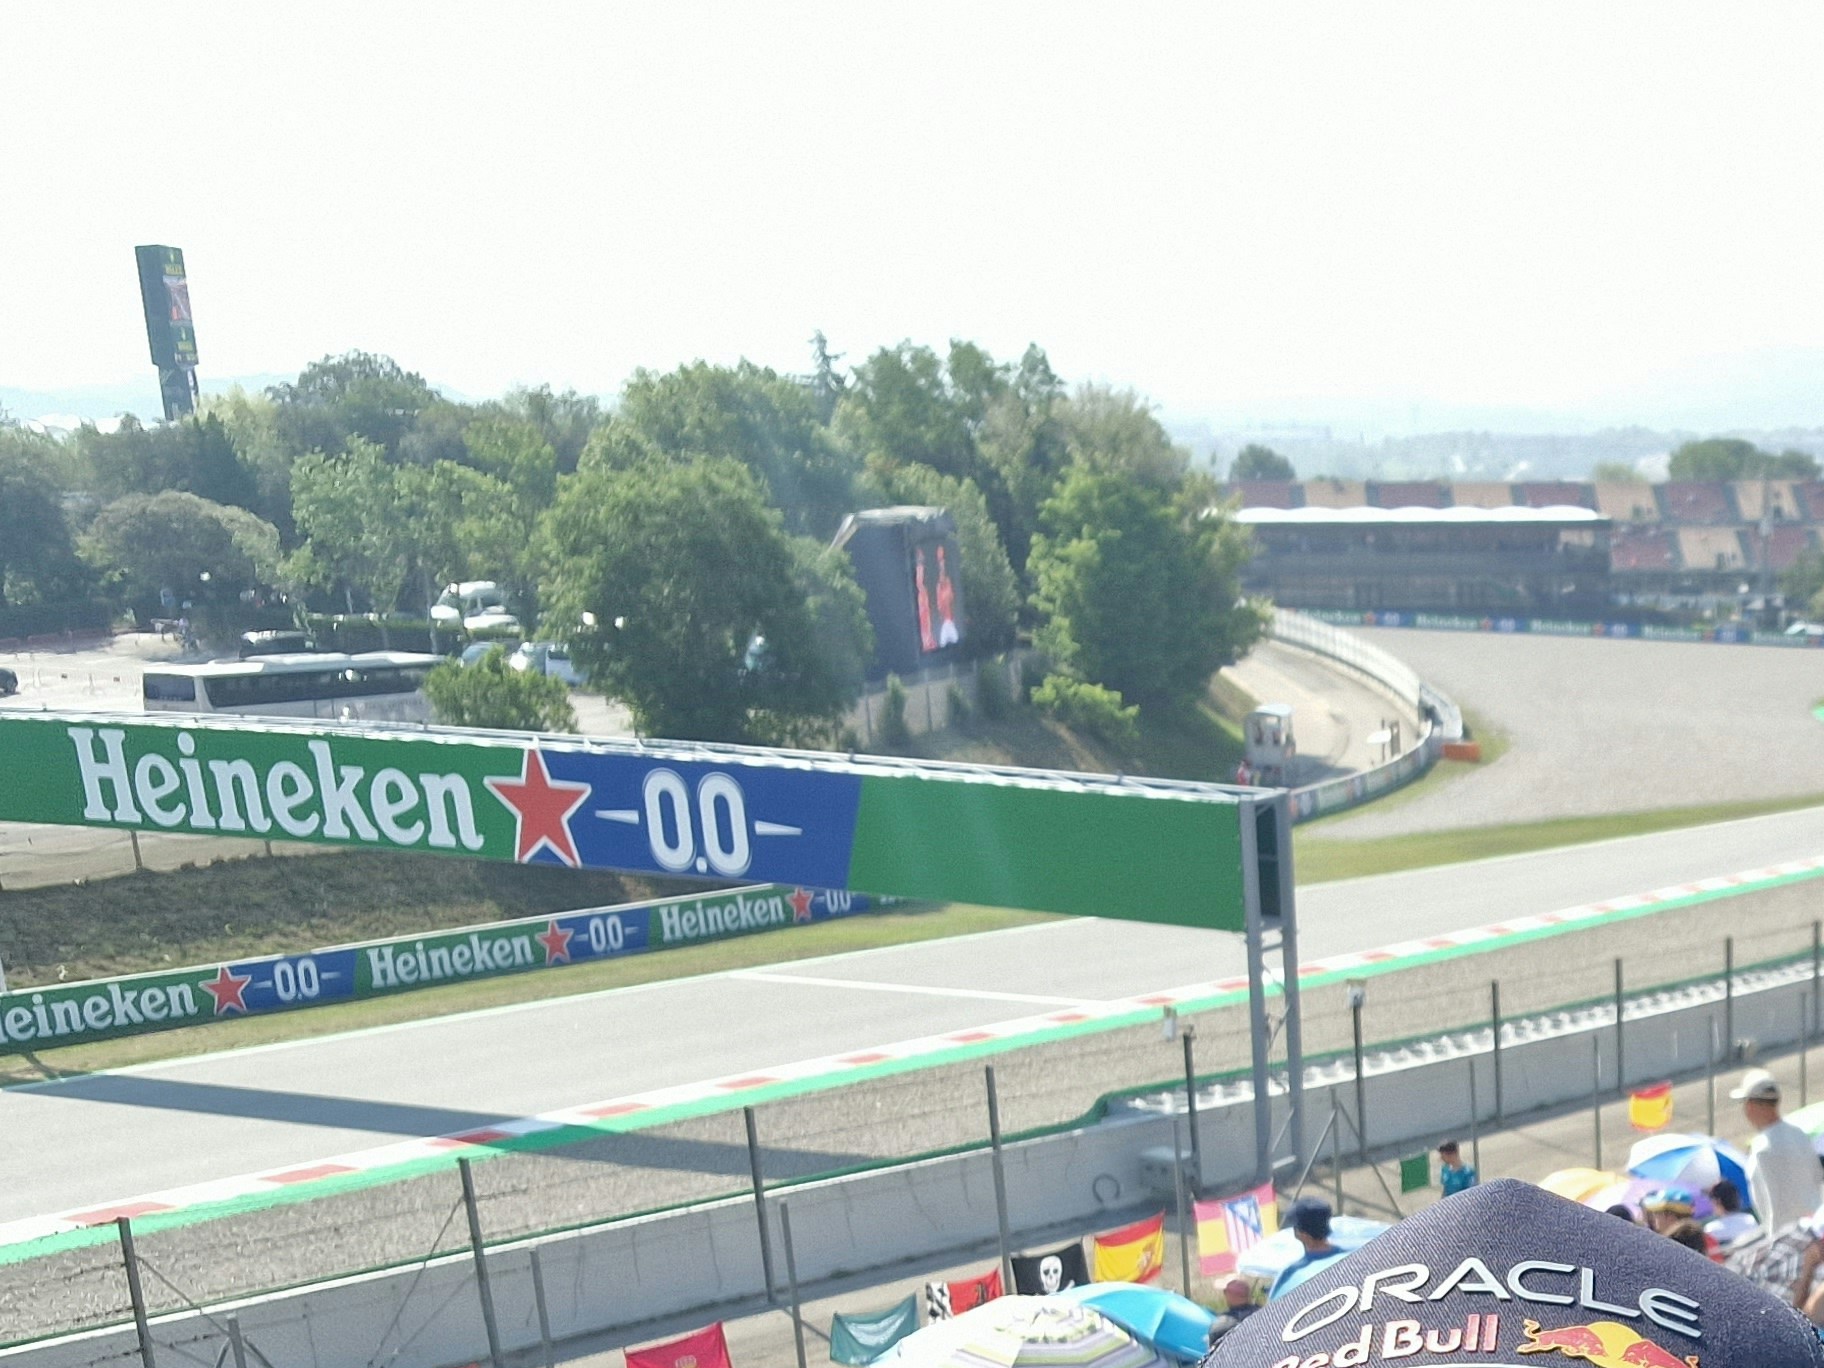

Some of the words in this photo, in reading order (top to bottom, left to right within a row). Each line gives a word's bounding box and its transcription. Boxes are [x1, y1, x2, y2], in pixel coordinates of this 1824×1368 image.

[68, 726, 484, 850] Heineken
[659, 895, 784, 942] Heineken
[367, 934, 534, 988] Heineken
[0, 983, 198, 1043] eineken
[1281, 1257, 1702, 1343] ORACLE
[1381, 1314, 1499, 1360] Bull
